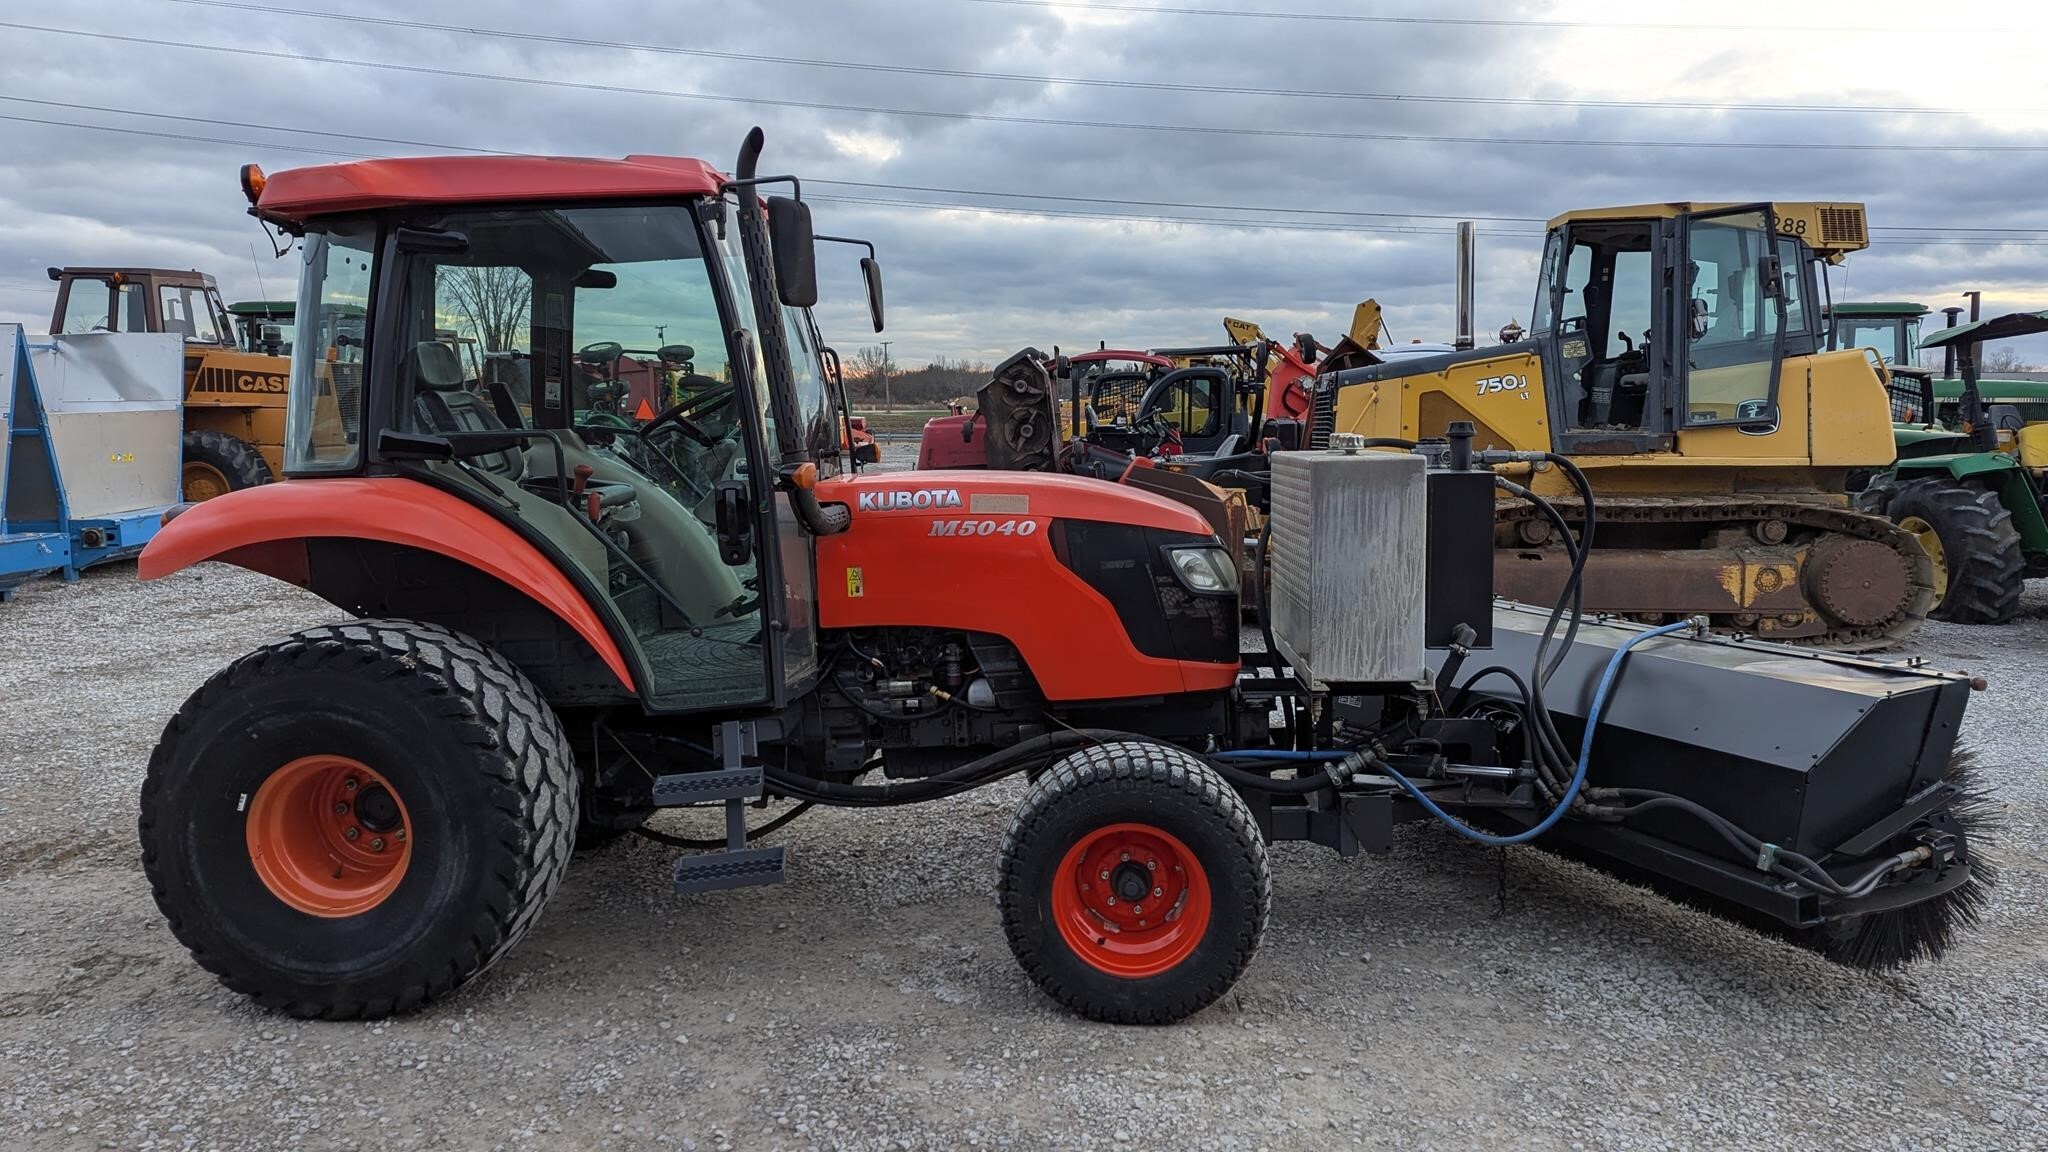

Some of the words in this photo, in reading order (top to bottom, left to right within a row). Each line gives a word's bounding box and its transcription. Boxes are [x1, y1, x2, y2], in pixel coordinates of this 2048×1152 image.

[1232, 321, 1251, 331] CAT
[1475, 374, 1528, 396] 750J
[1520, 391, 1530, 400] LT
[858, 488, 963, 512] KUBOTA
[927, 519, 1037, 538] M5040
